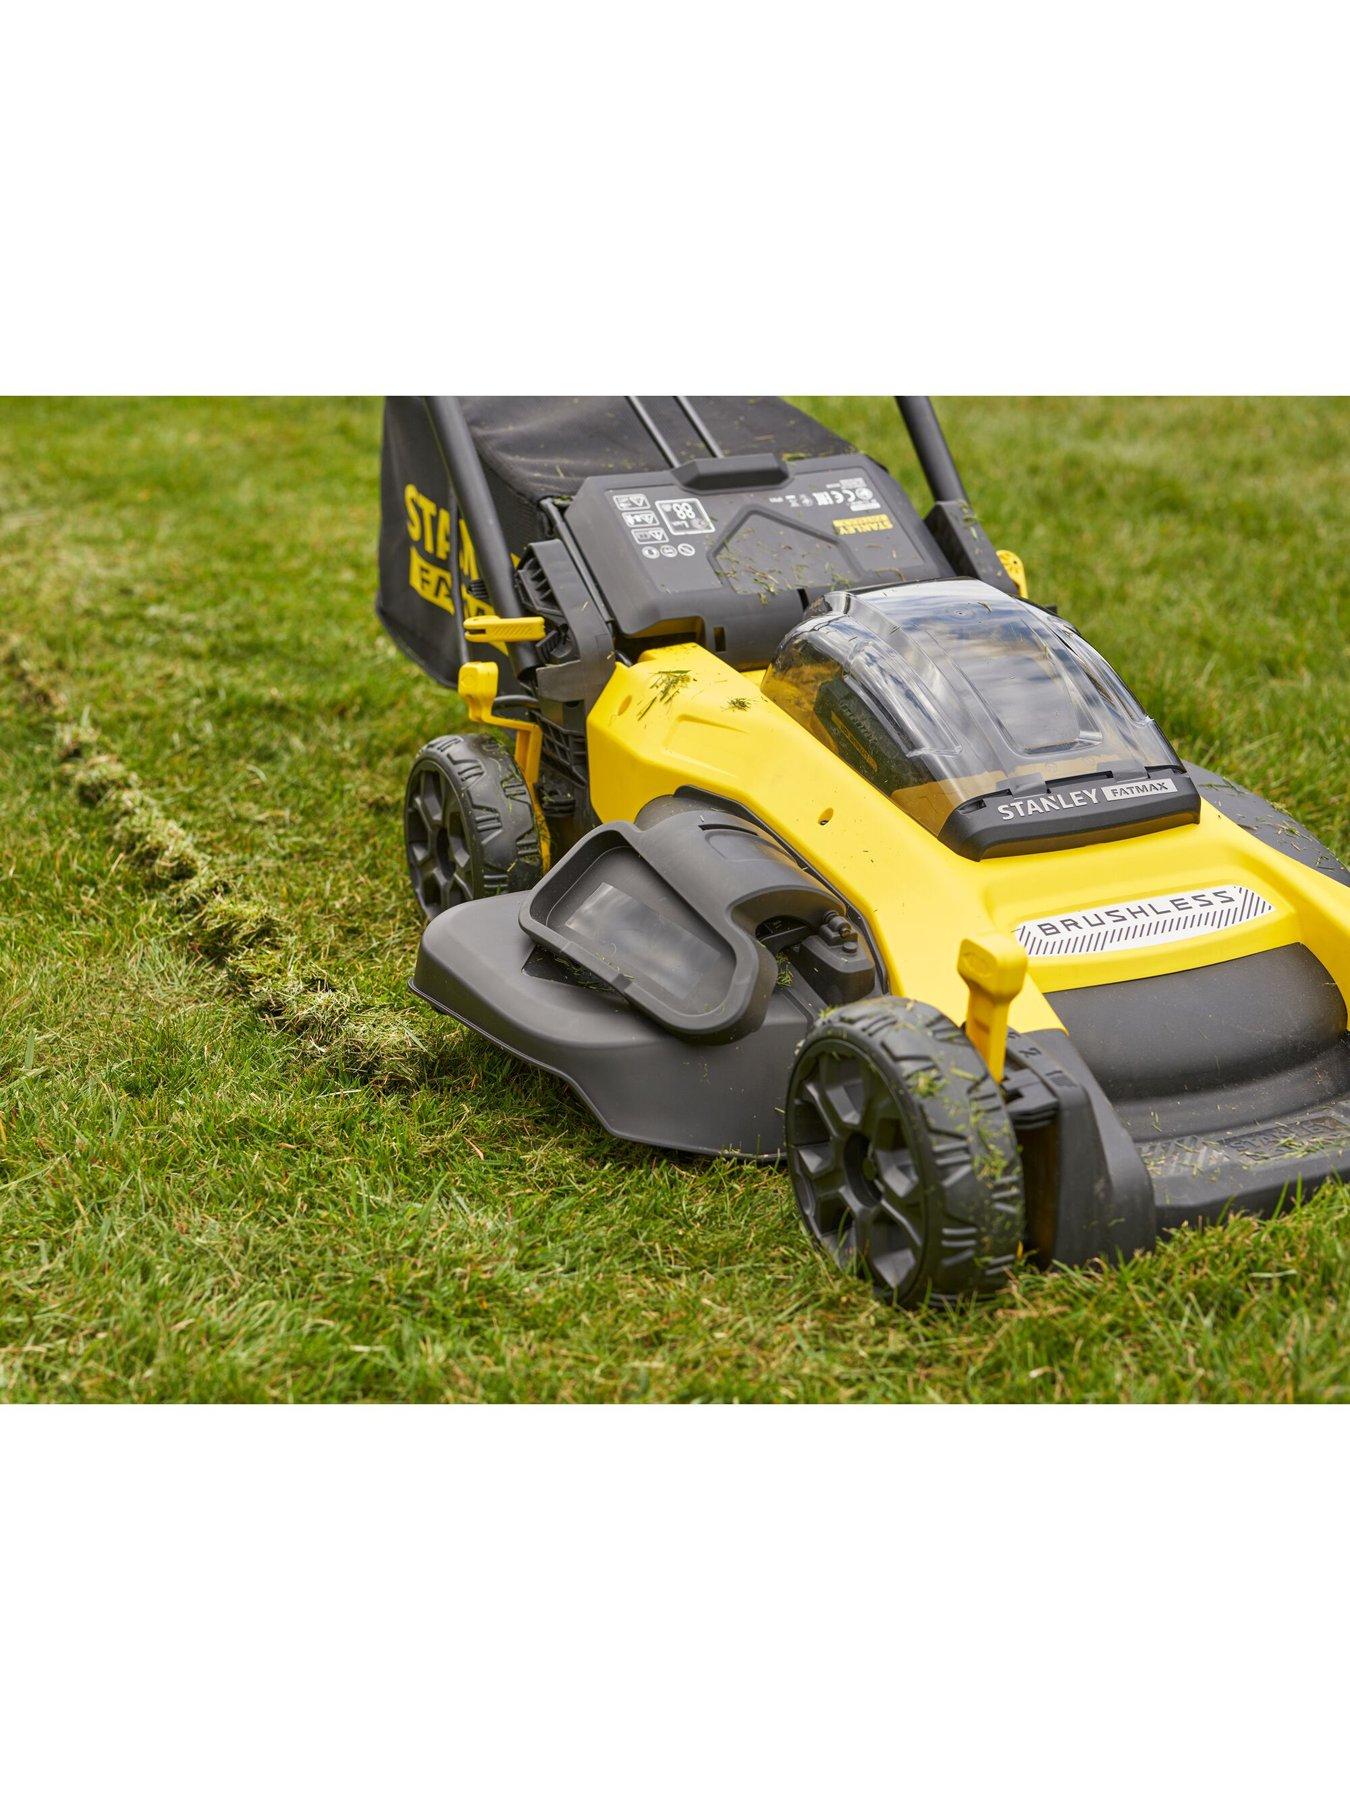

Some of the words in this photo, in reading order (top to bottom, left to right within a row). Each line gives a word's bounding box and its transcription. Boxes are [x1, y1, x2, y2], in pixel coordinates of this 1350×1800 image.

[997, 788, 1099, 821] STANLEY
[1110, 782, 1169, 797] FATMAX
[1036, 890, 1236, 937] BRUSHLESS
